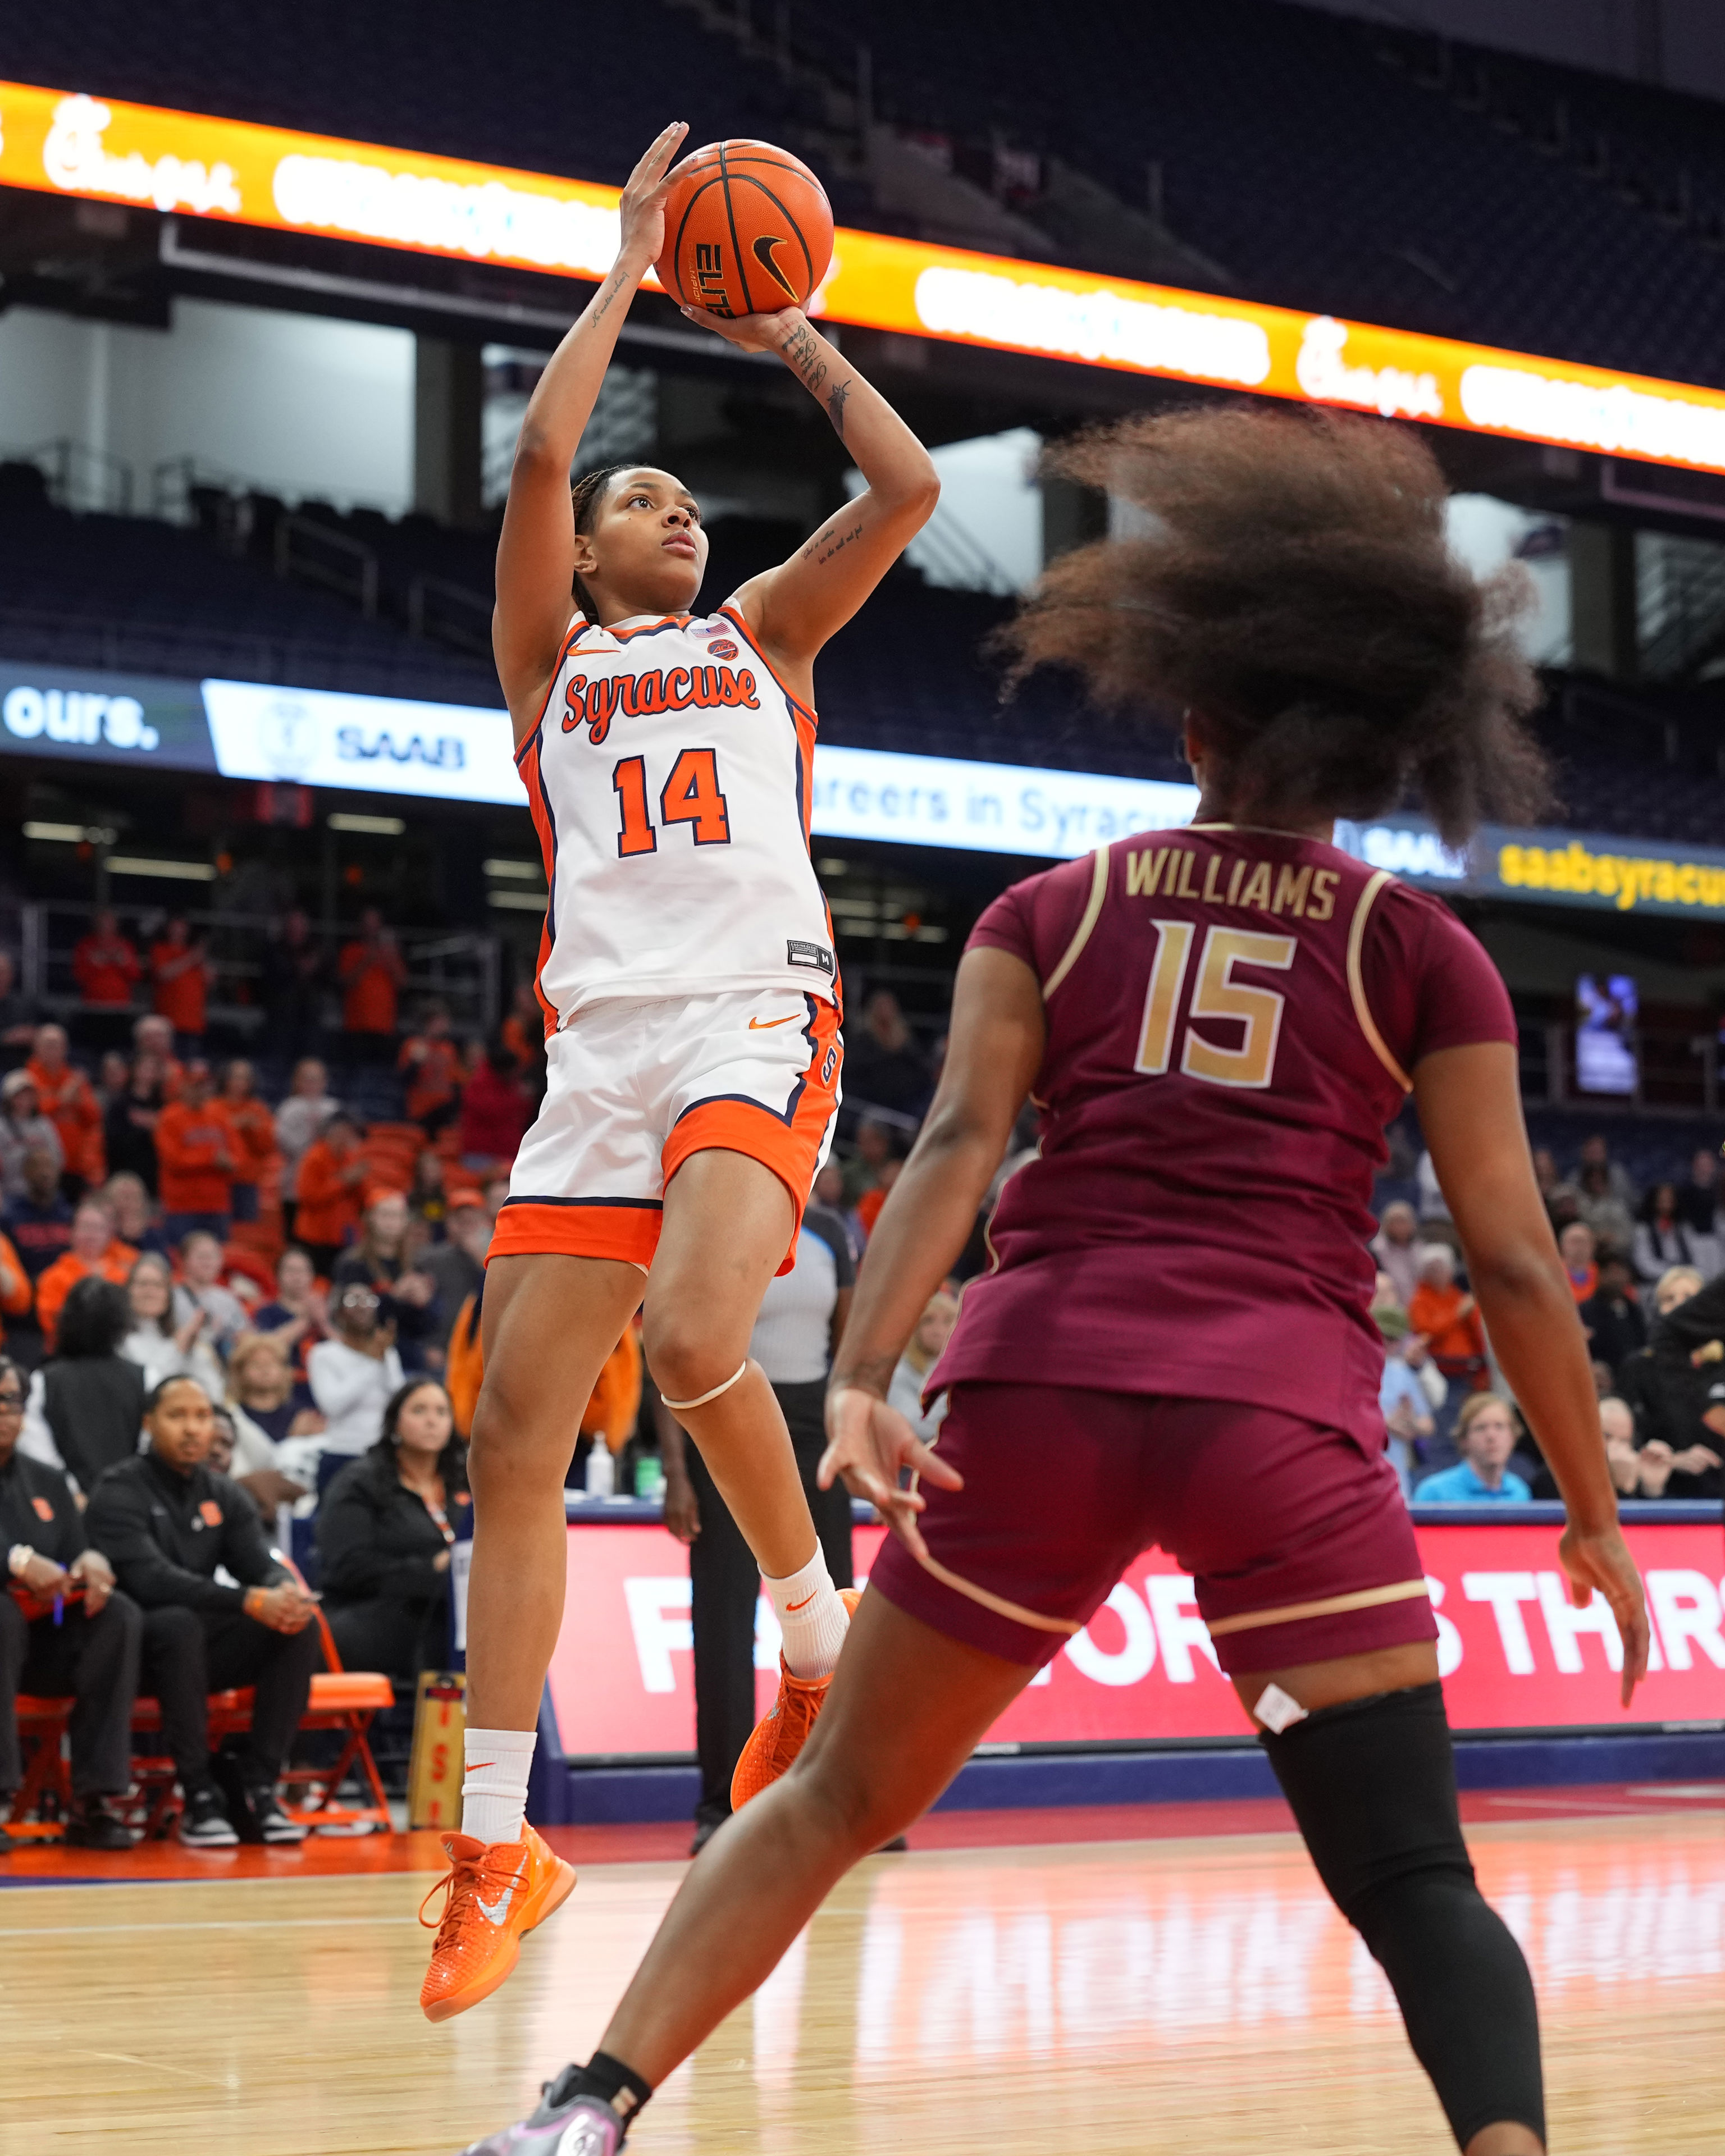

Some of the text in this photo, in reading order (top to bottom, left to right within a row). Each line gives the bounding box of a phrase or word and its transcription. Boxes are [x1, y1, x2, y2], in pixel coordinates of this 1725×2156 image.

[713, 642, 736, 654] ACC
[3, 685, 159, 751] ours.
[562, 666, 761, 745] Syracuse
[336, 724, 465, 771] SAAB
[612, 747, 731, 858] 14
[965, 782, 1005, 828] in
[1125, 847, 1341, 921] WILLIAMS
[822, 953, 829, 965] M
[1133, 917, 1298, 1089] 15
[822, 1045, 837, 1084] S
